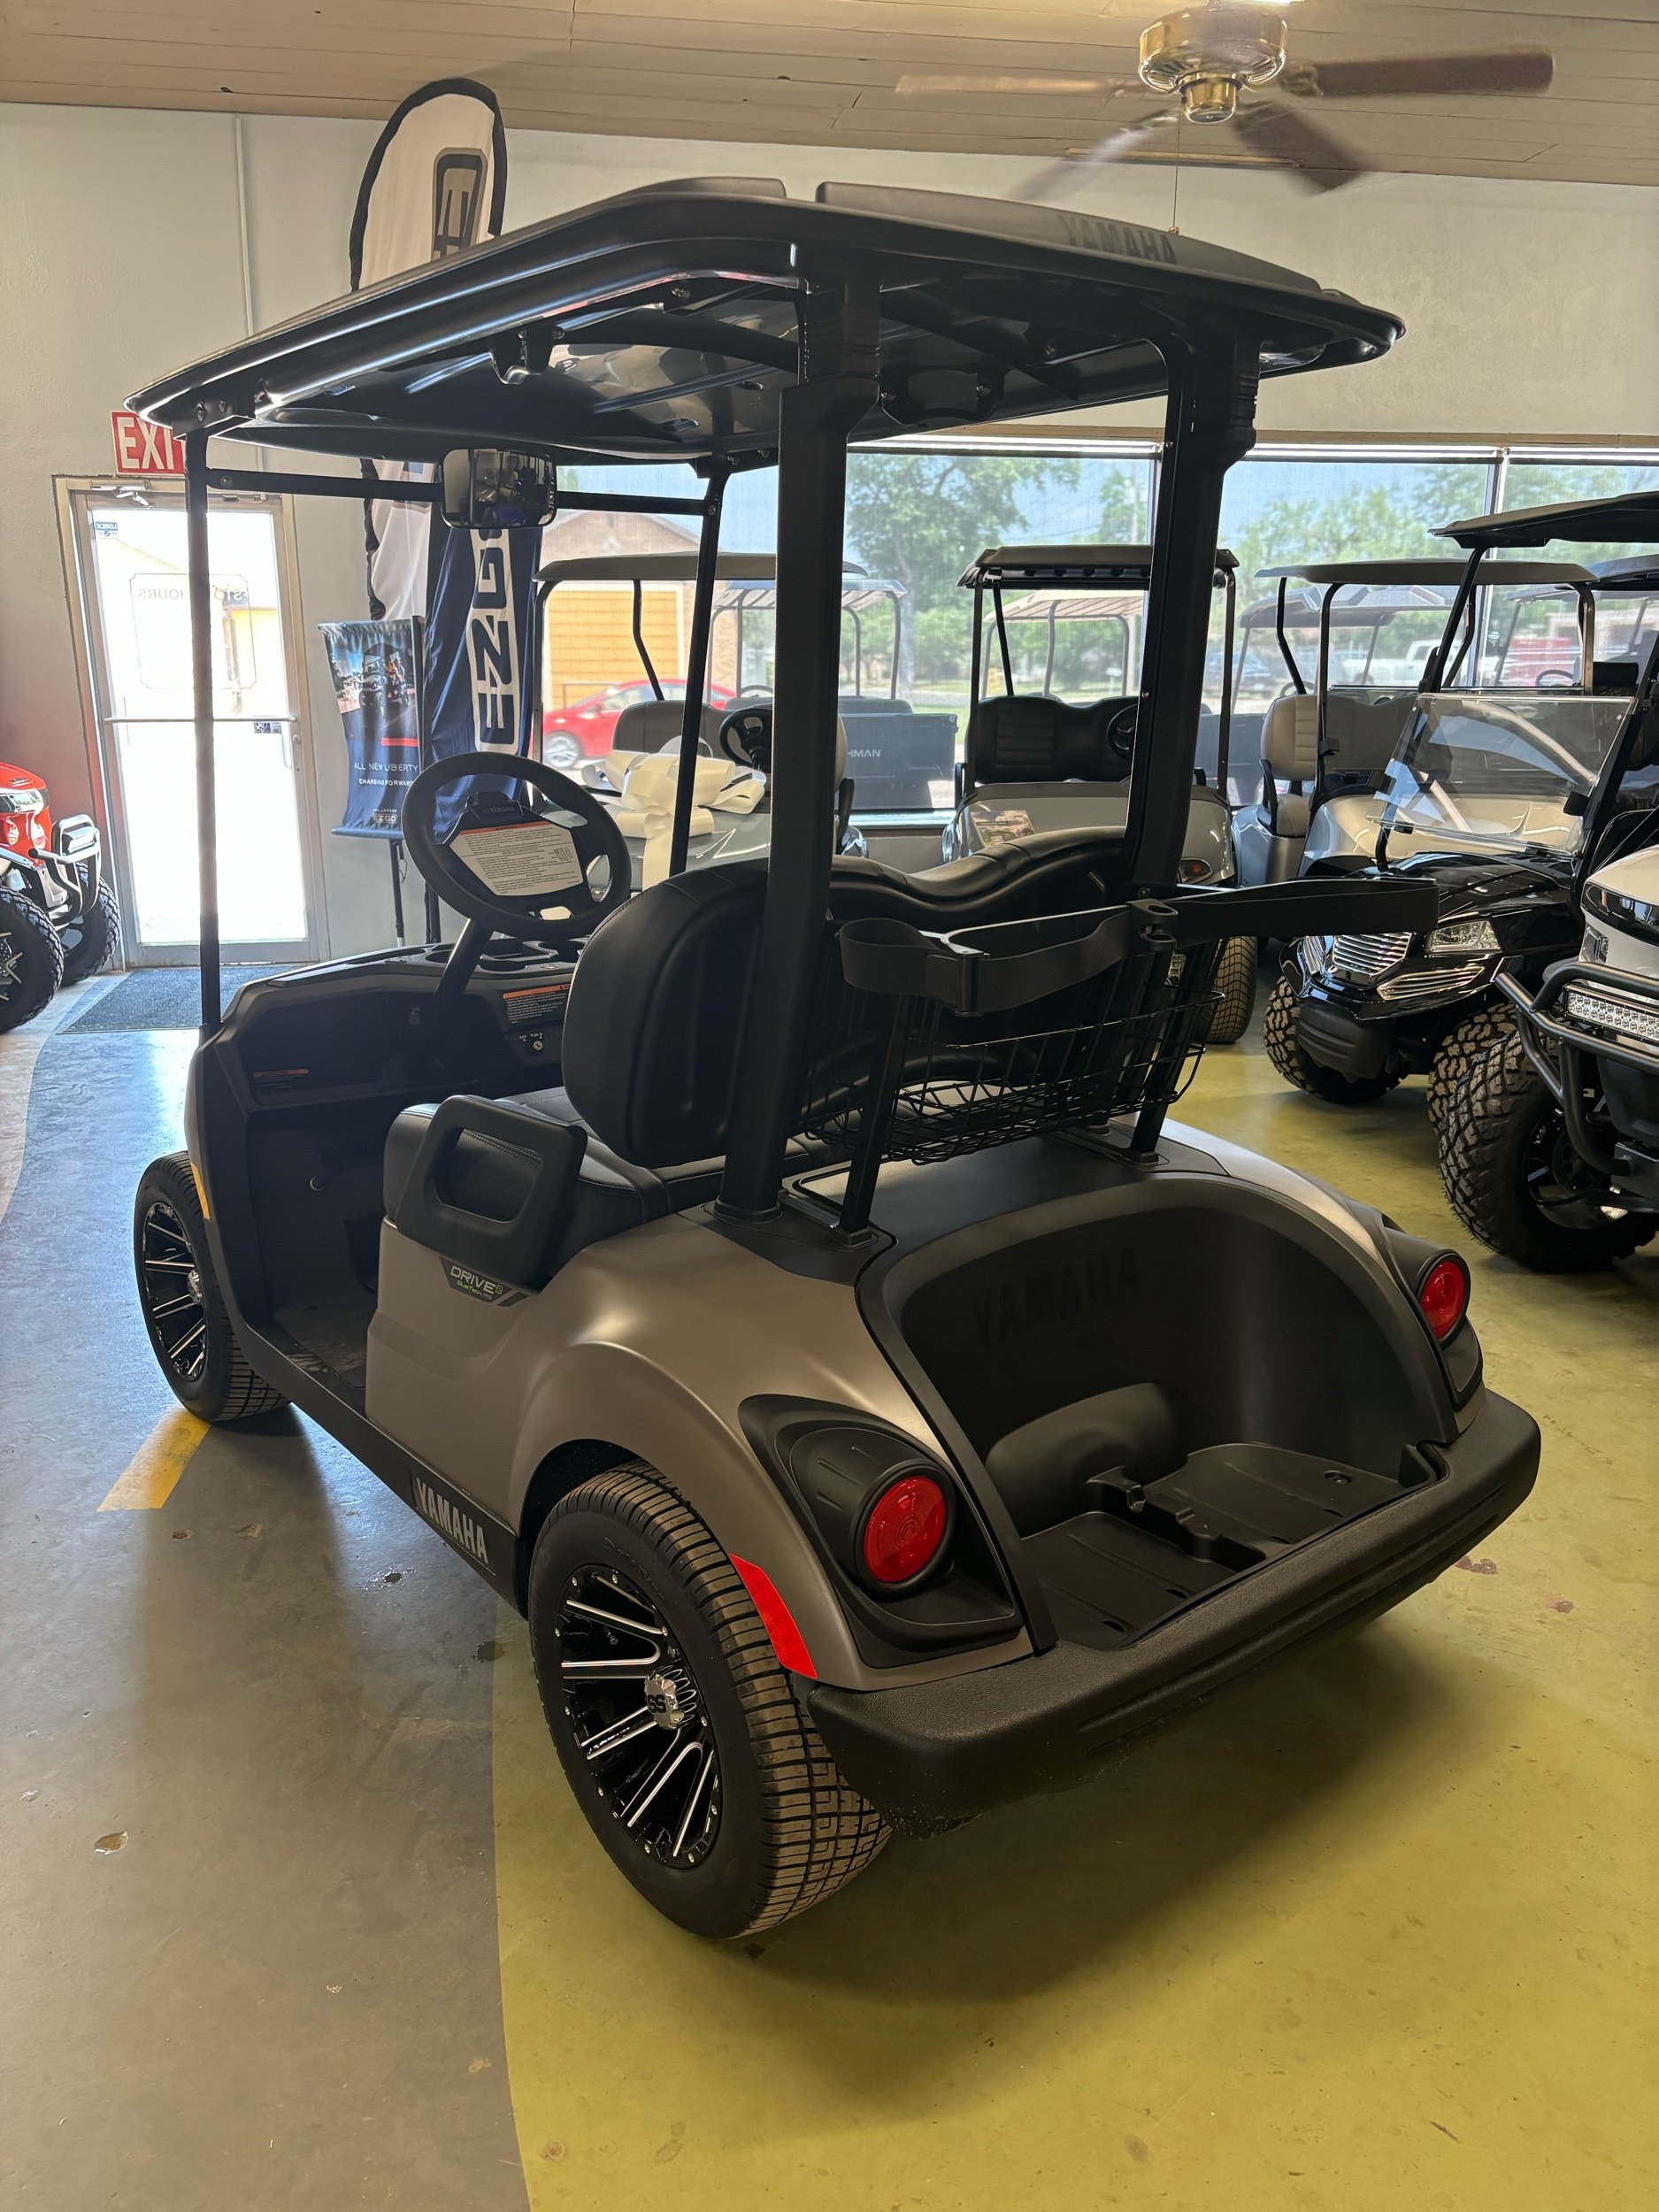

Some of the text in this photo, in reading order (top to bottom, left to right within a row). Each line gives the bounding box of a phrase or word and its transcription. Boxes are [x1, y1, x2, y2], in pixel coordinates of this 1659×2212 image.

[1057, 215, 1178, 265] YAMAHA
[117, 417, 185, 470] EXI
[847, 749, 881, 758] HMAN
[972, 1246, 1142, 1348] YAMAHA
[416, 1477, 489, 1564] YAMAHA
